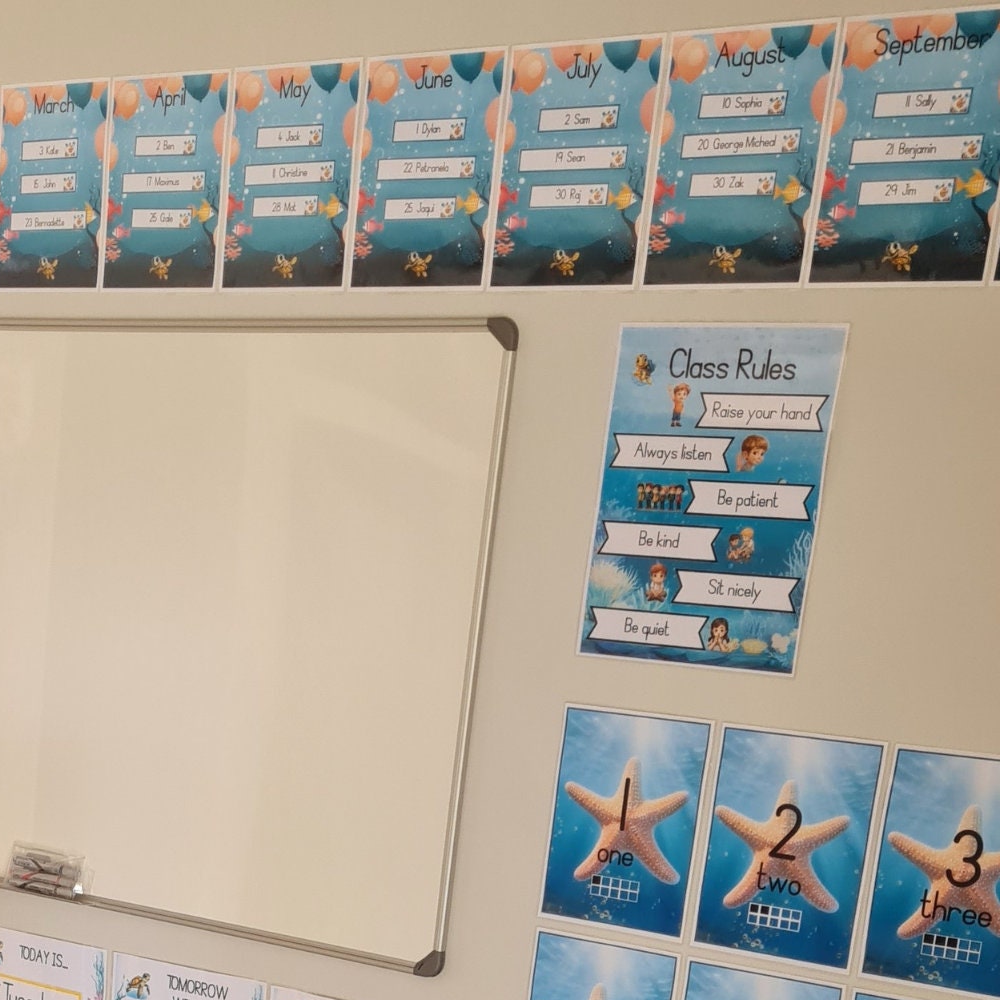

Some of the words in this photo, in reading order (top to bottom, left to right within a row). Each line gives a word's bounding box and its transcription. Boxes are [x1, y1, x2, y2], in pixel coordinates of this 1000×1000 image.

[874, 22, 989, 66] September
[715, 37, 786, 77] August
[415, 65, 453, 89] June
[567, 53, 602, 87] July
[153, 87, 186, 116] April
[279, 76, 311, 107] May
[915, 94, 937, 111] Sally
[34, 93, 74, 115] March
[722, 97, 731, 109] 10
[735, 96, 762, 112] Sophia
[422, 123, 441, 137] Dylan
[564, 114, 570, 125] 2
[574, 113, 590, 124] Sam
[156, 141, 160, 150] 2
[163, 140, 174, 150] Ben
[285, 131, 300, 141] Jack
[698, 139, 709, 150] 20
[713, 138, 743, 153] George
[555, 152, 563, 163] 19
[567, 151, 585, 162] Sean
[885, 143, 894, 155] 21
[898, 142, 937, 159] Benjamin
[713, 177, 725, 188] 30
[729, 176, 744, 188] Zak
[885, 184, 898, 196] 29
[902, 184, 916, 196] Jim
[555, 189, 566, 199] 30
[669, 348, 729, 379] Class
[736, 348, 796, 381] Rules
[712, 401, 744, 419] Raise
[746, 408, 777, 426] your
[781, 402, 812, 421] hand
[635, 442, 678, 466] Always
[681, 444, 712, 461] listen
[717, 489, 733, 507] Be
[735, 492, 779, 512] patient
[639, 531, 653, 547] Be
[656, 531, 679, 549] kind
[708, 579, 724, 596] Sit
[728, 584, 762, 604] nicely
[624, 617, 638, 634] Be
[641, 619, 670, 640] quiet
[619, 777, 630, 831] 1
[769, 804, 802, 861] 2
[597, 847, 633, 867] one
[945, 830, 983, 888] 3
[756, 862, 802, 896] two
[920, 889, 992, 928] three
[19, 944, 49, 967] TODAY
[167, 974, 229, 1000] TOMORROW
